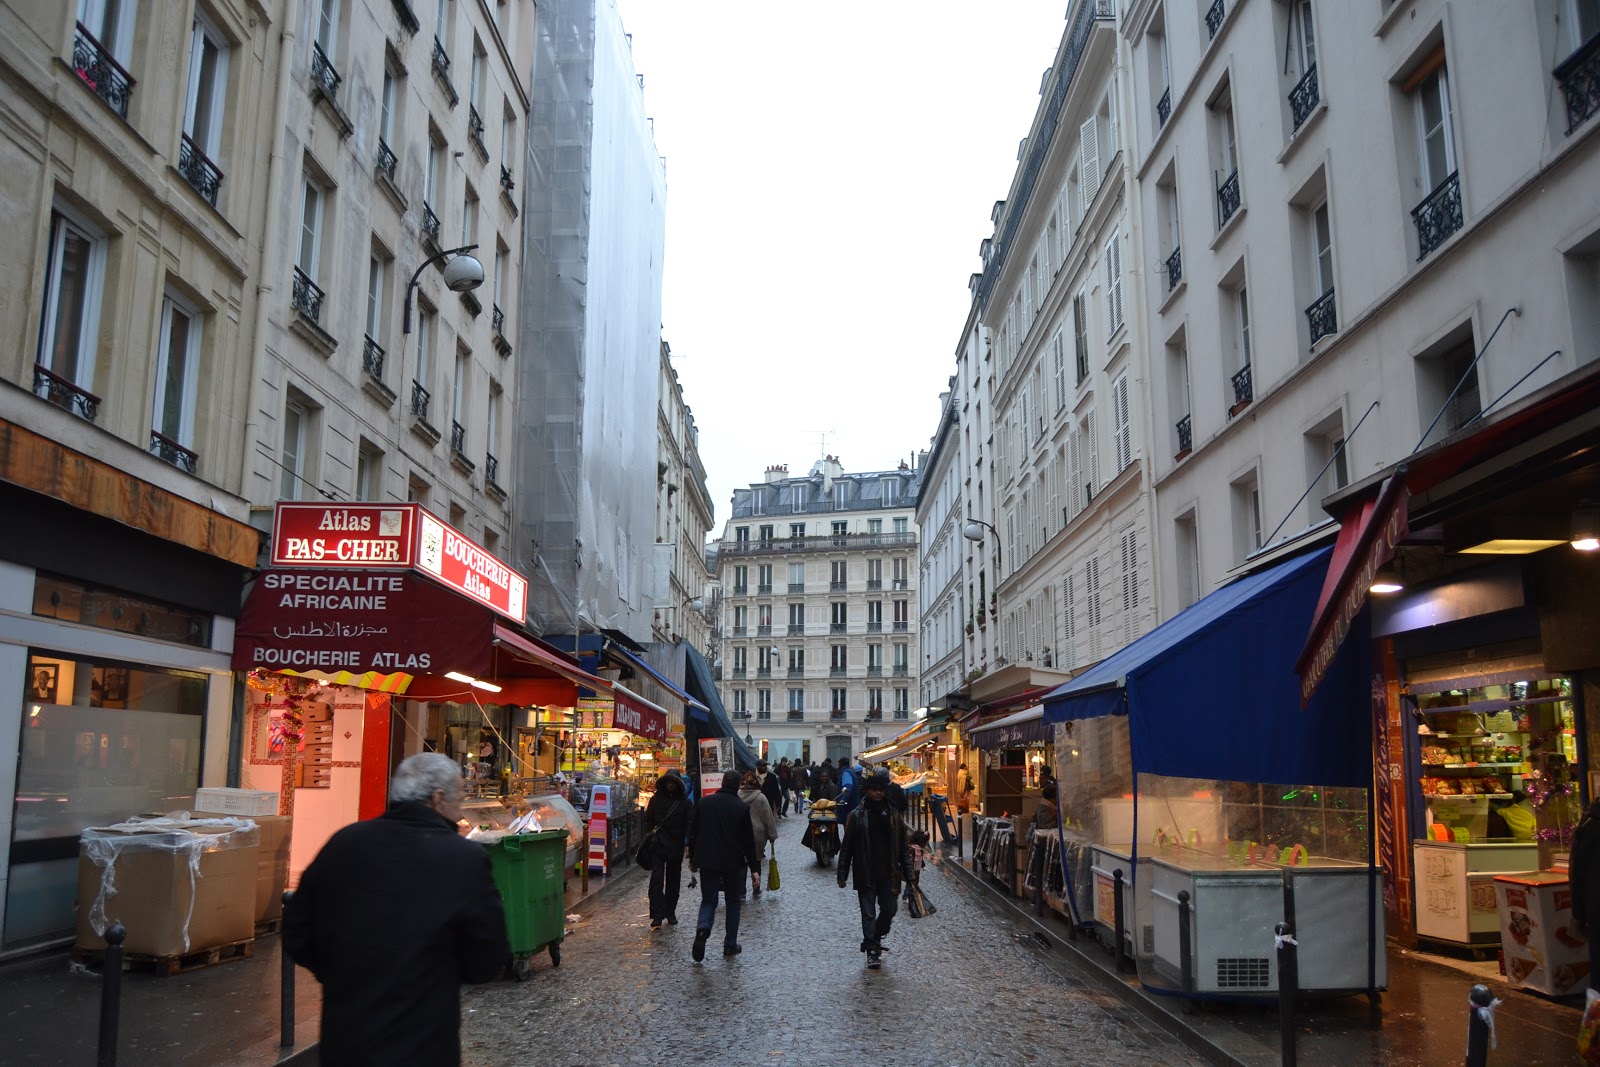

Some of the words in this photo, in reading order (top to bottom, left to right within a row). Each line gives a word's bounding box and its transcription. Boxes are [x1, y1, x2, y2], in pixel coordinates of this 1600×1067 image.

[319, 510, 371, 532] Atlas
[285, 538, 400, 562] PAS-CHER
[444, 532, 509, 590] BOUCHERIE
[264, 574, 404, 592] SPECIALITE
[463, 569, 491, 600] Atlas
[279, 594, 387, 610] AFRICAINE
[253, 648, 361, 666] BOUCHERIE
[371, 652, 431, 668] ATLAS
[1375, 715, 1389, 793] Rose
